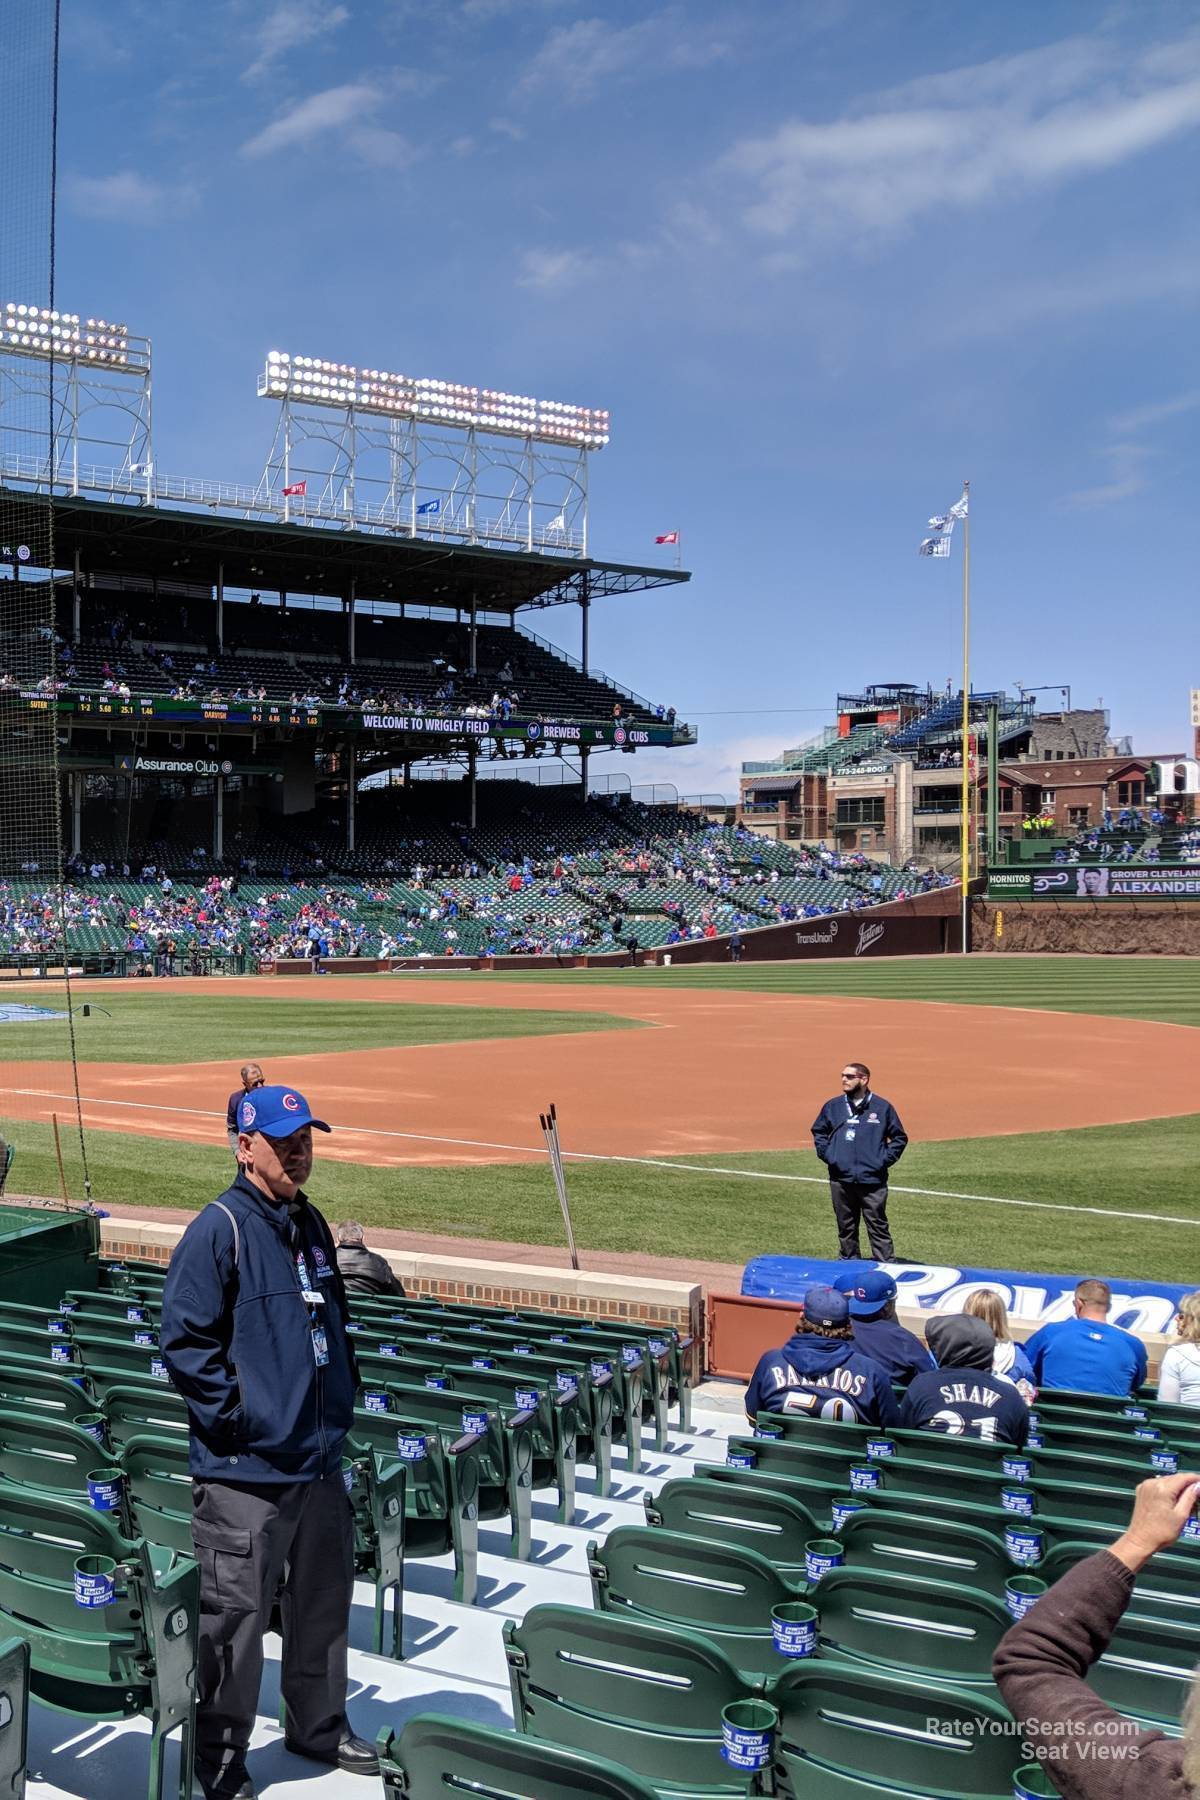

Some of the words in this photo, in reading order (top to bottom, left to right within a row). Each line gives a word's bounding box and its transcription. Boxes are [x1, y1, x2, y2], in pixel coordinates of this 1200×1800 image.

[363, 715, 408, 730] WELCOME
[411, 717, 423, 730] TO
[425, 718, 464, 733] WRIGLEY
[466, 721, 490, 734] FIELD
[543, 727, 581, 740] BREWERS
[595, 730, 604, 739] VS.
[629, 731, 649, 743] CUBS
[135, 757, 194, 772] Assurance
[195, 760, 219, 773] Club
[989, 874, 1031, 884] HORNITOS
[1111, 870, 1148, 879] GROVER
[1150, 870, 1200, 879] CLEVELAN
[796, 932, 833, 944] TransUnion
[940, 1383, 1002, 1409] SHAW
[785, 1626, 807, 1635] Hefty
[780, 1644, 801, 1652] Hefty
[735, 1733, 763, 1746] Hefty
[729, 1752, 755, 1767] Hefty
